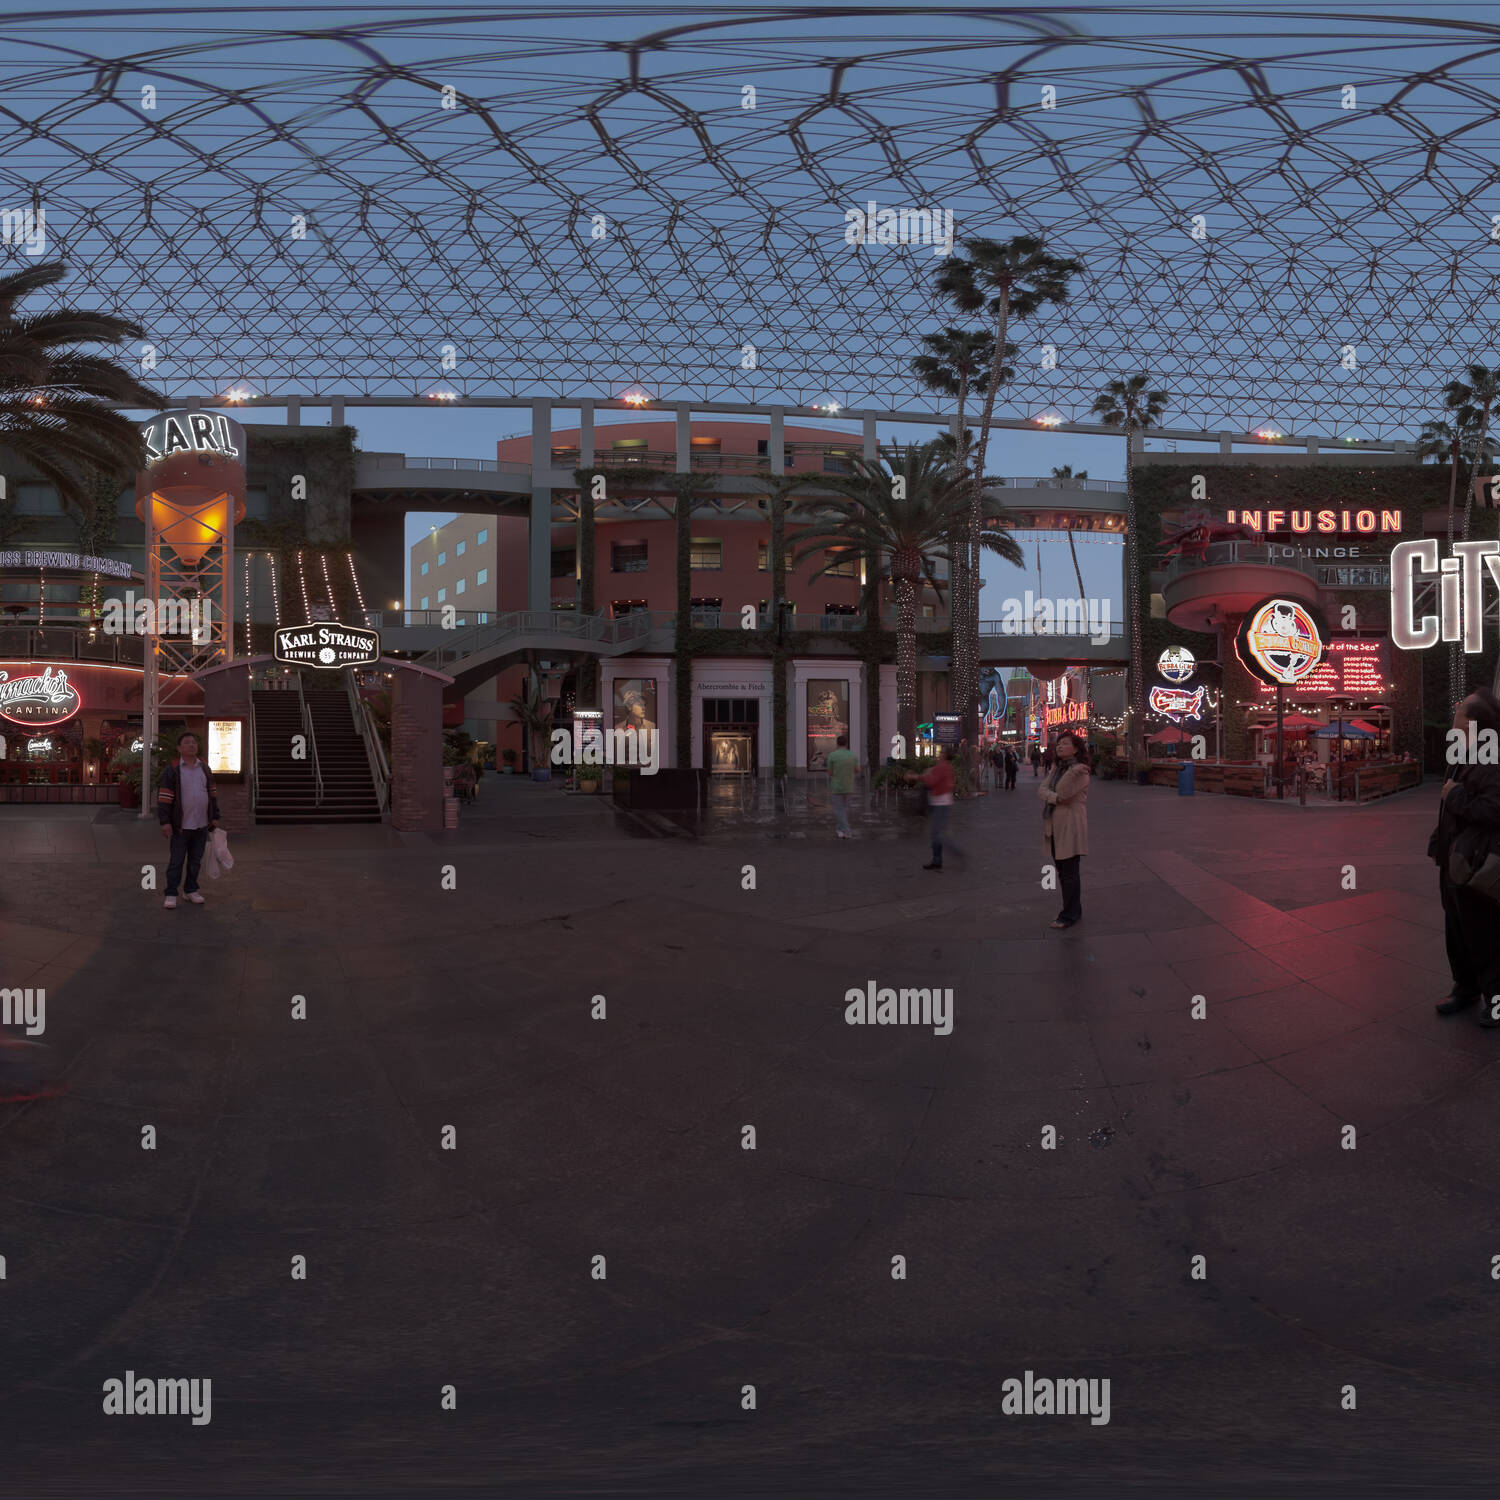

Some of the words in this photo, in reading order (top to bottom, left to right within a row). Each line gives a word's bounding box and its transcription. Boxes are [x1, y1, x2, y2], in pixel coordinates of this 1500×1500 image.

[143, 414, 239, 461] KARL
[1227, 510, 1402, 533] INFUSION
[25, 551, 80, 569] BREWING
[82, 555, 132, 578] COMPANY
[279, 632, 317, 651] KARL
[319, 628, 374, 652] STRAUSS
[1346, 643, 1359, 651] the
[284, 651, 316, 659] BREWING
[338, 651, 369, 660] COMPANY
[5, 706, 69, 715] CANTINA
